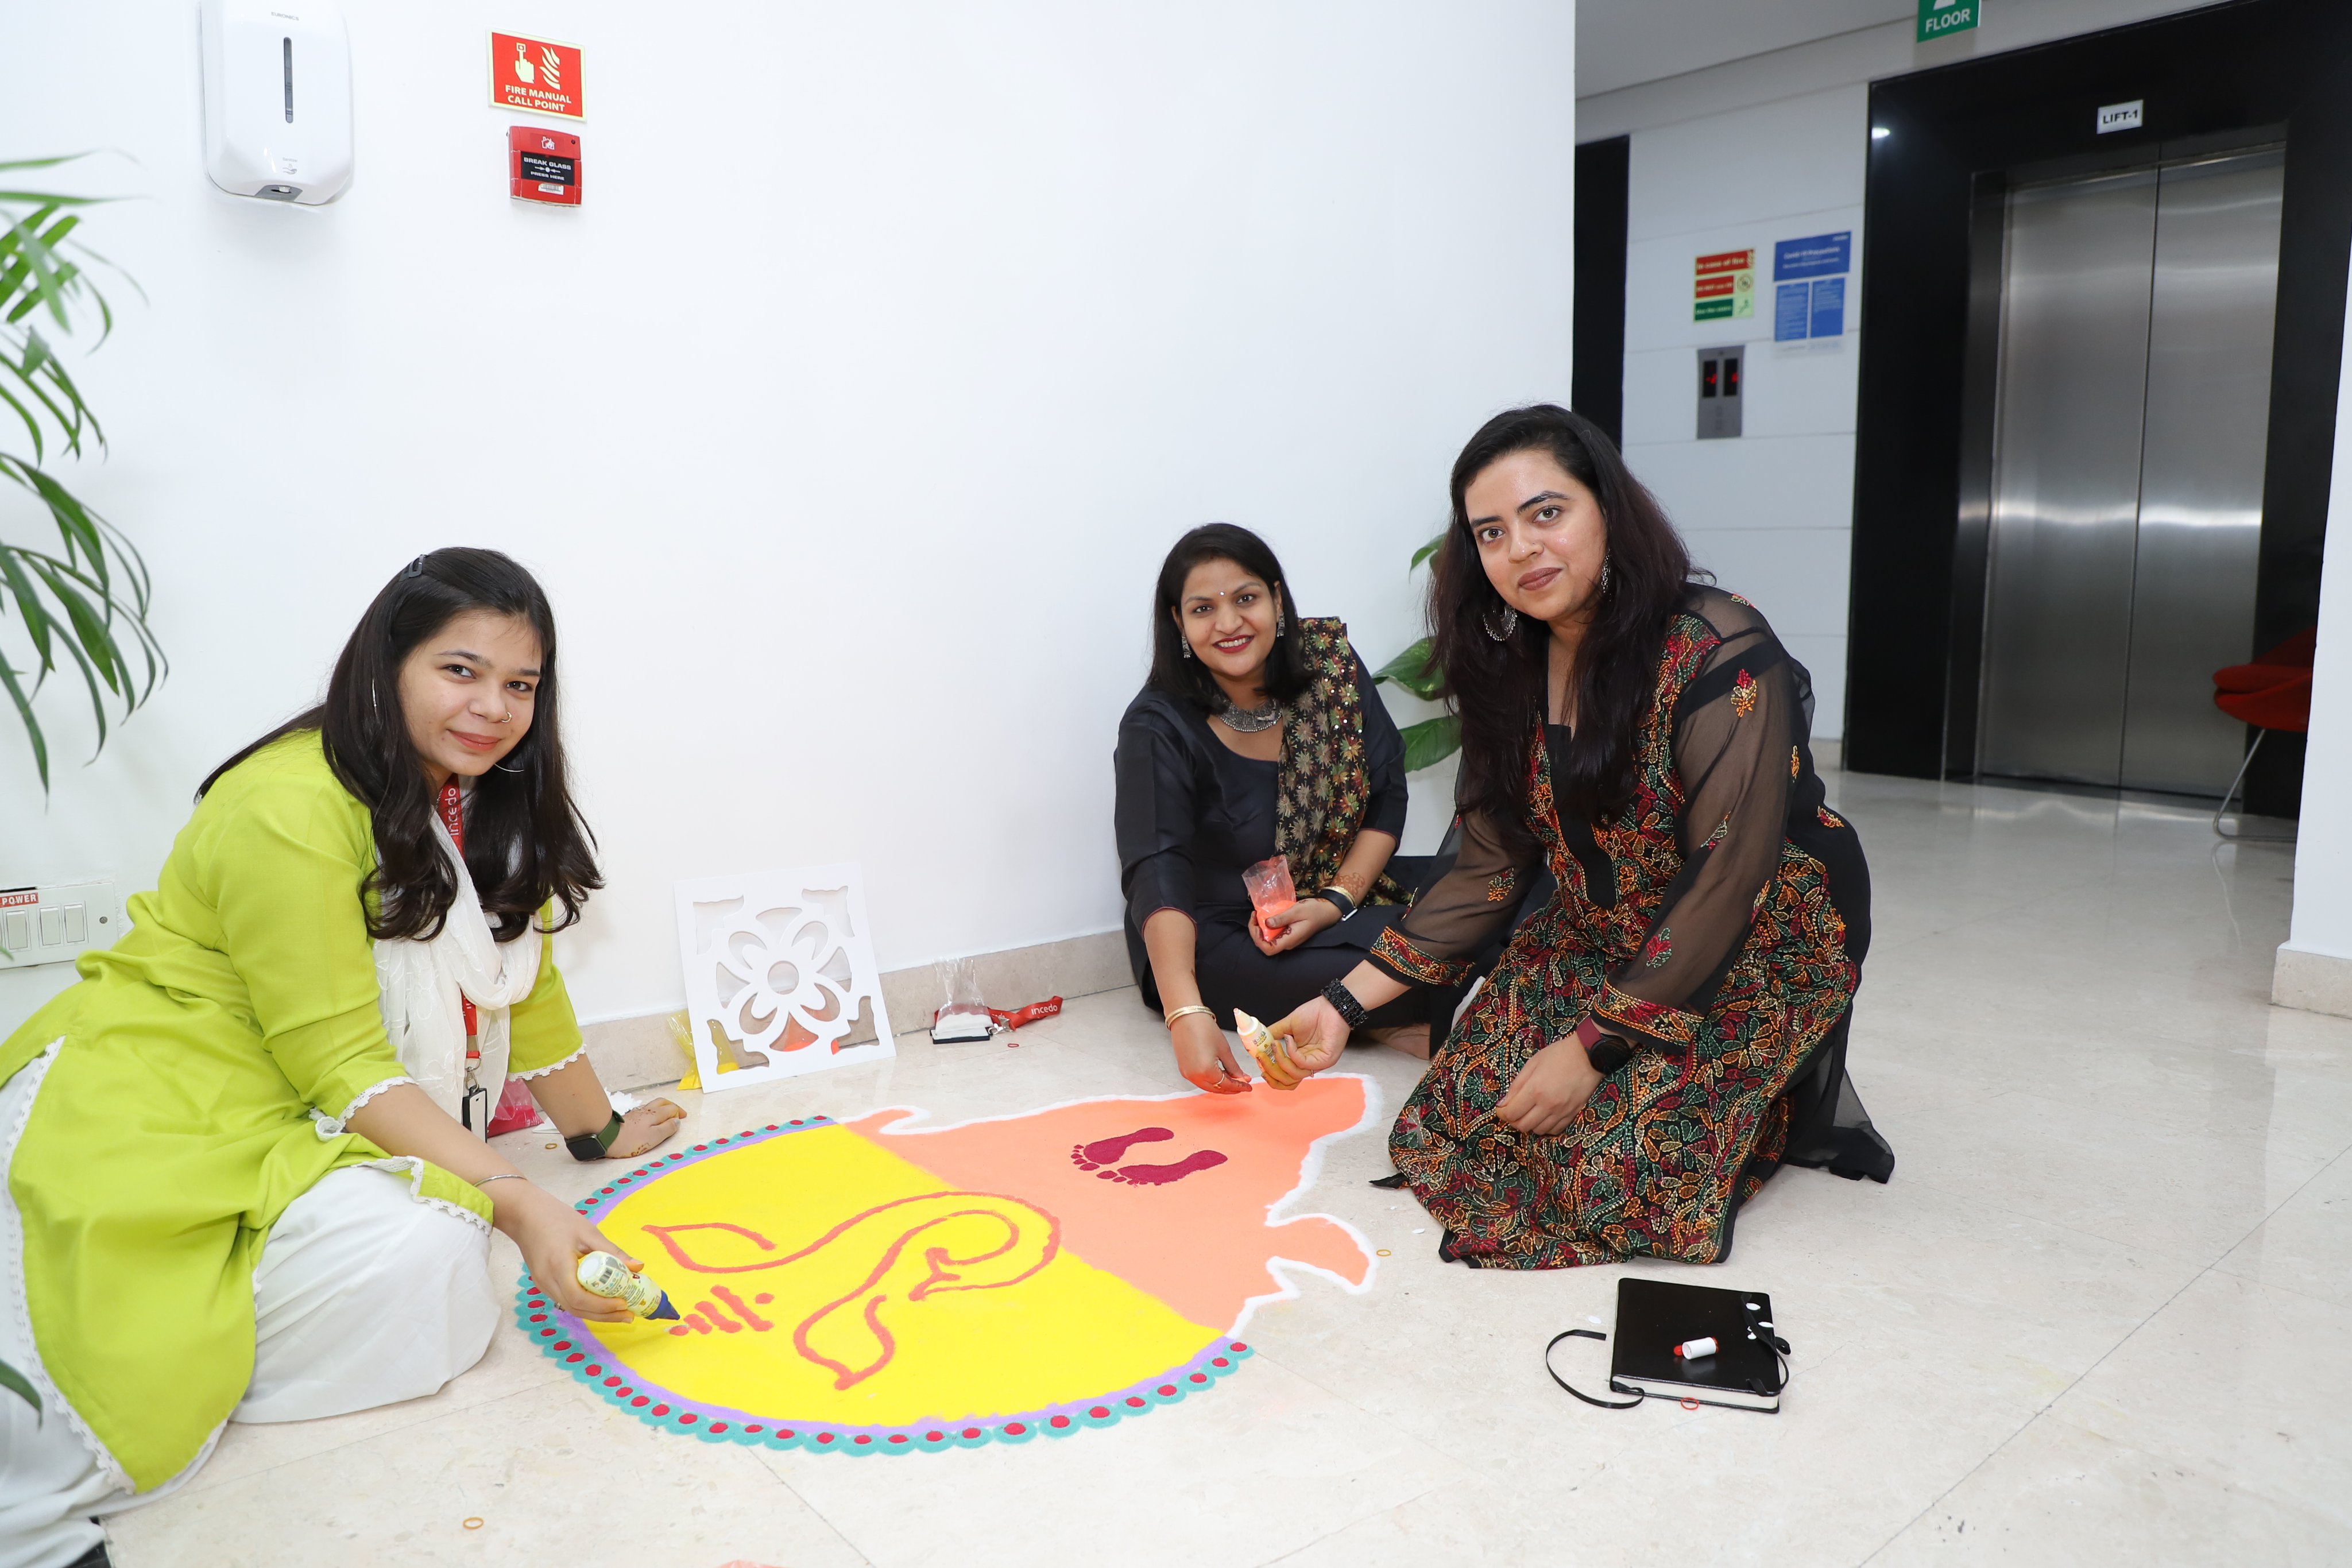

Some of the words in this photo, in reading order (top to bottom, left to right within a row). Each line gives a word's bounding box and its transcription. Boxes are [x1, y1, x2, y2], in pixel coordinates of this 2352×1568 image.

[1925, 8, 1971, 33] FLOOR
[505, 84, 527, 96] FIRE
[529, 88, 572, 103] MANUAL
[507, 95, 533, 106] CALL
[535, 99, 565, 112] POINT
[2103, 109, 2138, 124] LIFT-1
[523, 157, 547, 166] BREAK
[548, 162, 571, 171] GLASS
[2, 894, 36, 905] POWER
